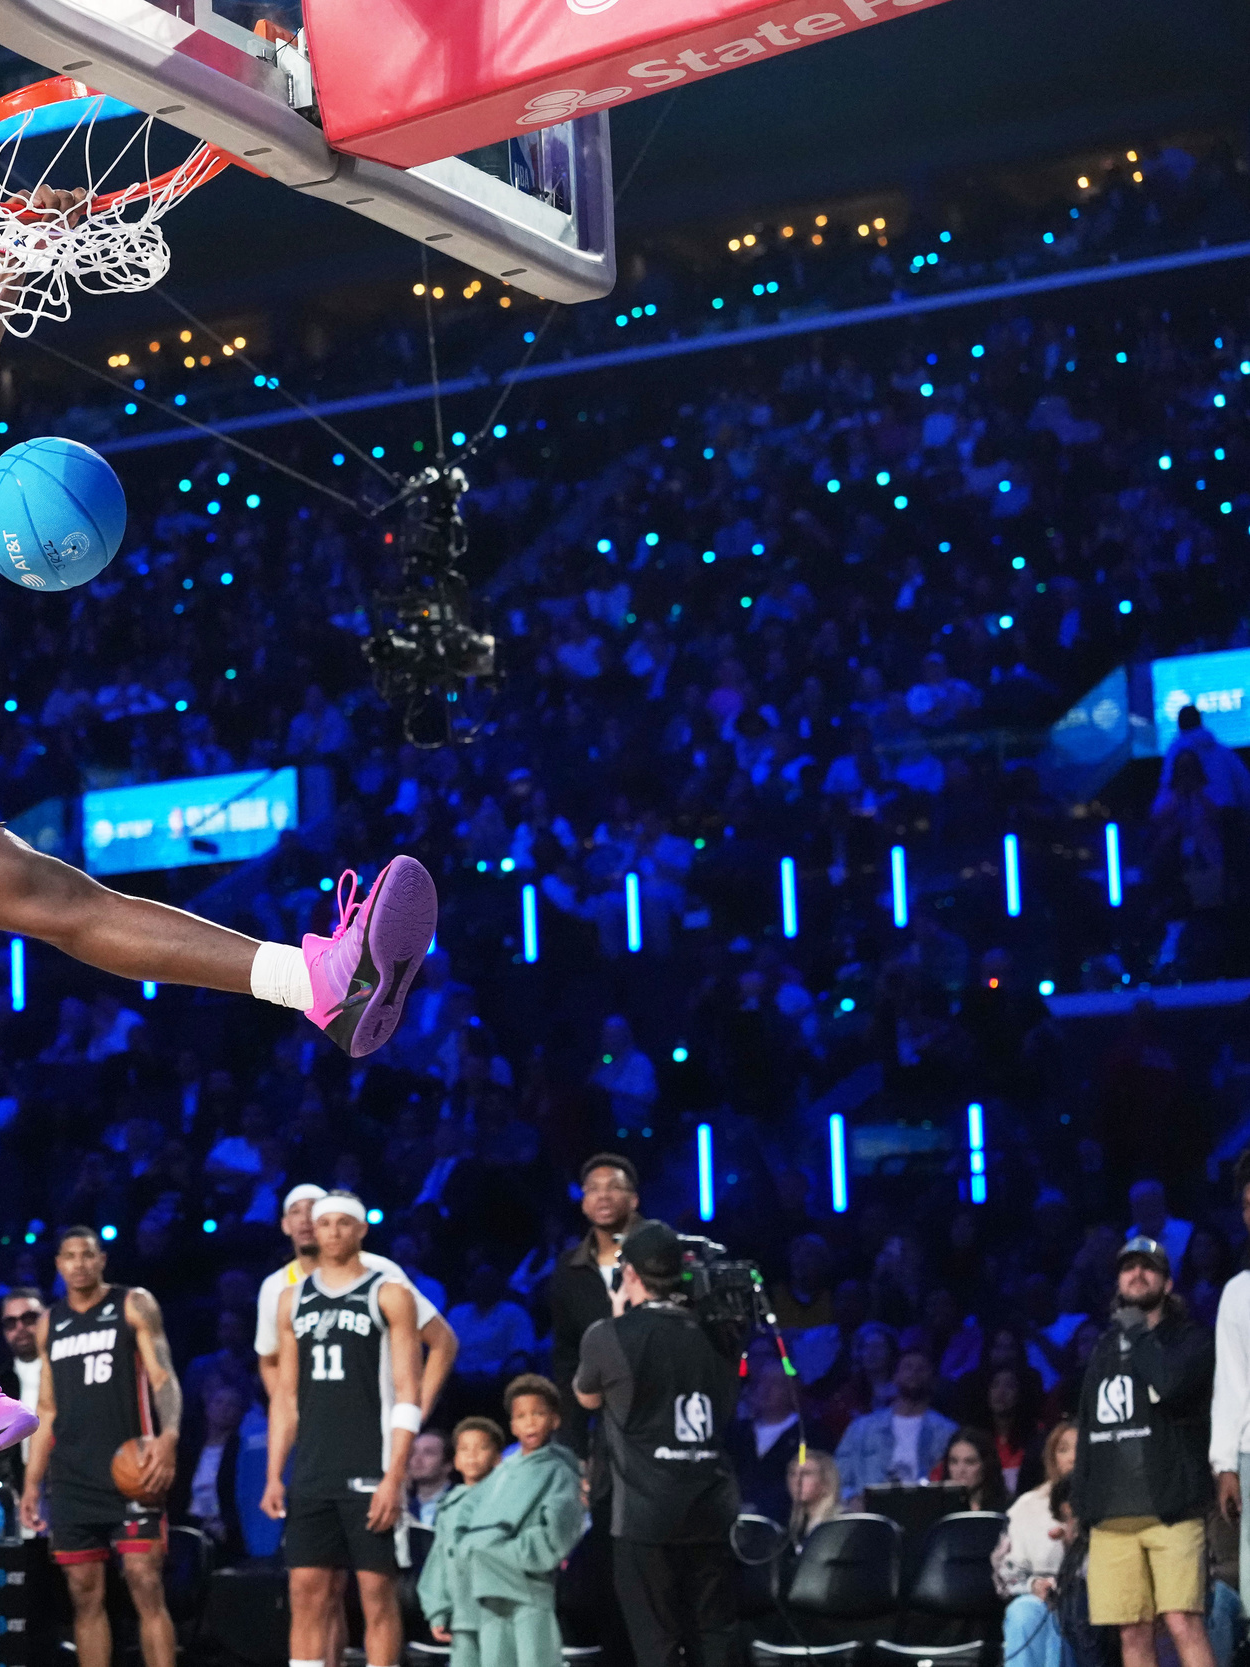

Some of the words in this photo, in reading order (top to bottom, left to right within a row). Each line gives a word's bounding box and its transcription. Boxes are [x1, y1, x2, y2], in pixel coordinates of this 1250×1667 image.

[627, 12, 847, 89] State
[2, 530, 31, 571] AT&T
[50, 1327, 117, 1362] MIAMI
[311, 1344, 345, 1380] 11
[83, 1352, 114, 1386] 16
